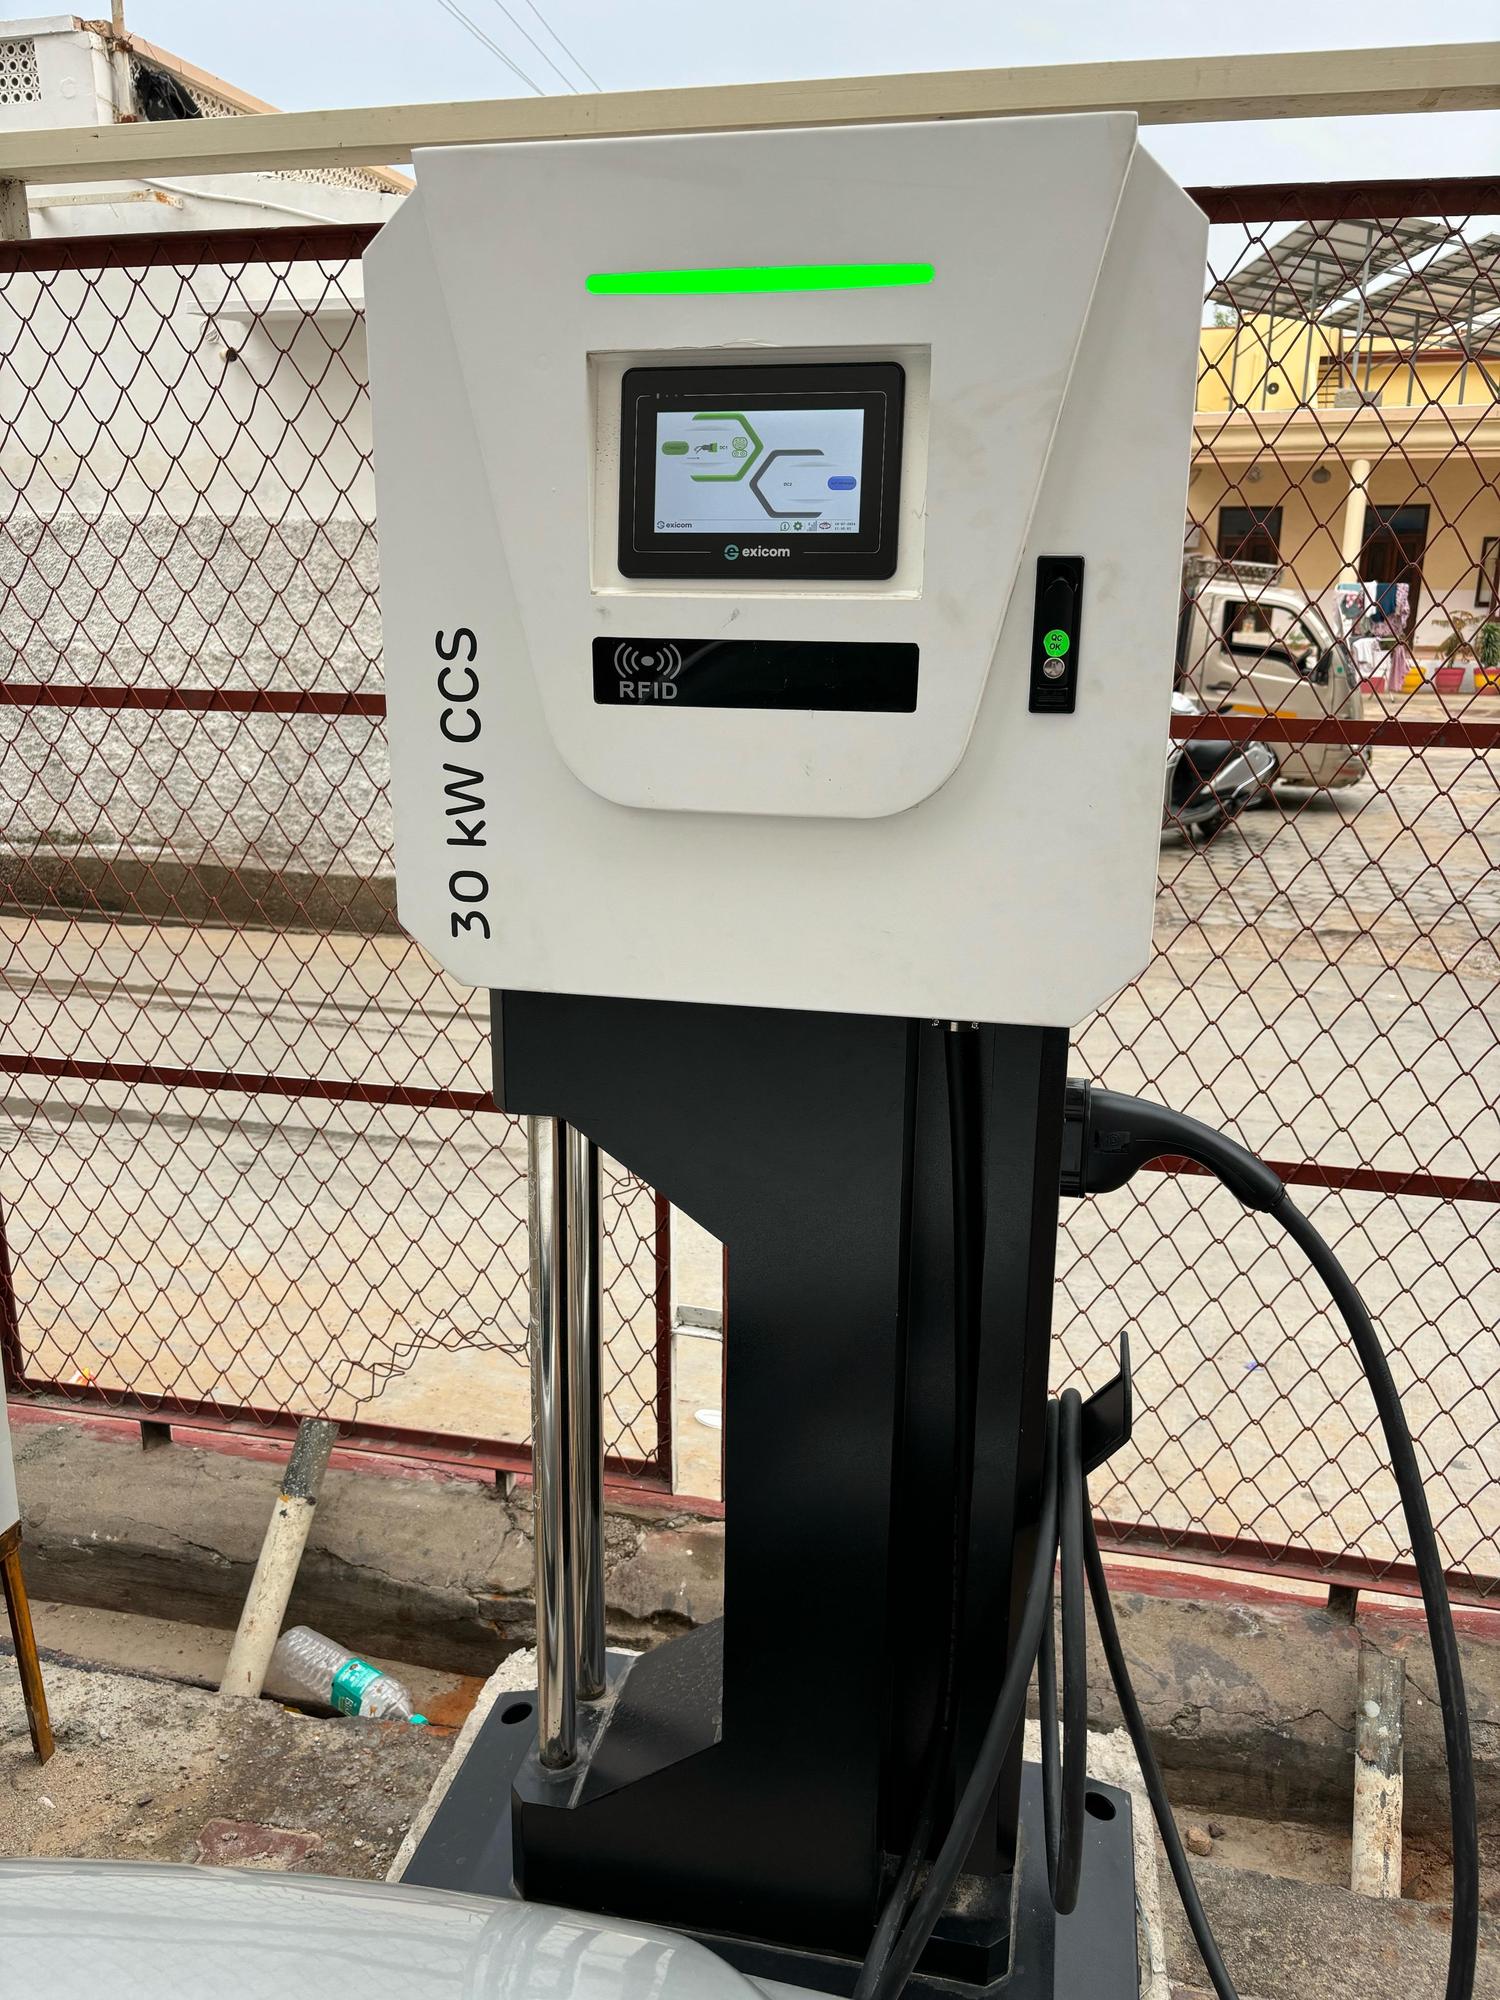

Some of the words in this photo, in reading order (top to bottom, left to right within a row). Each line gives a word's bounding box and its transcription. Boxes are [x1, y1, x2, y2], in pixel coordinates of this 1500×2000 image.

[665, 521, 692, 529] exicom
[742, 545, 790, 557] exicom
[1051, 633, 1063, 641] QC
[1049, 642, 1061, 651] OK
[435, 627, 482, 743] CCS
[619, 680, 678, 700] RFID
[442, 762, 487, 847] kW
[448, 870, 491, 940] 30
